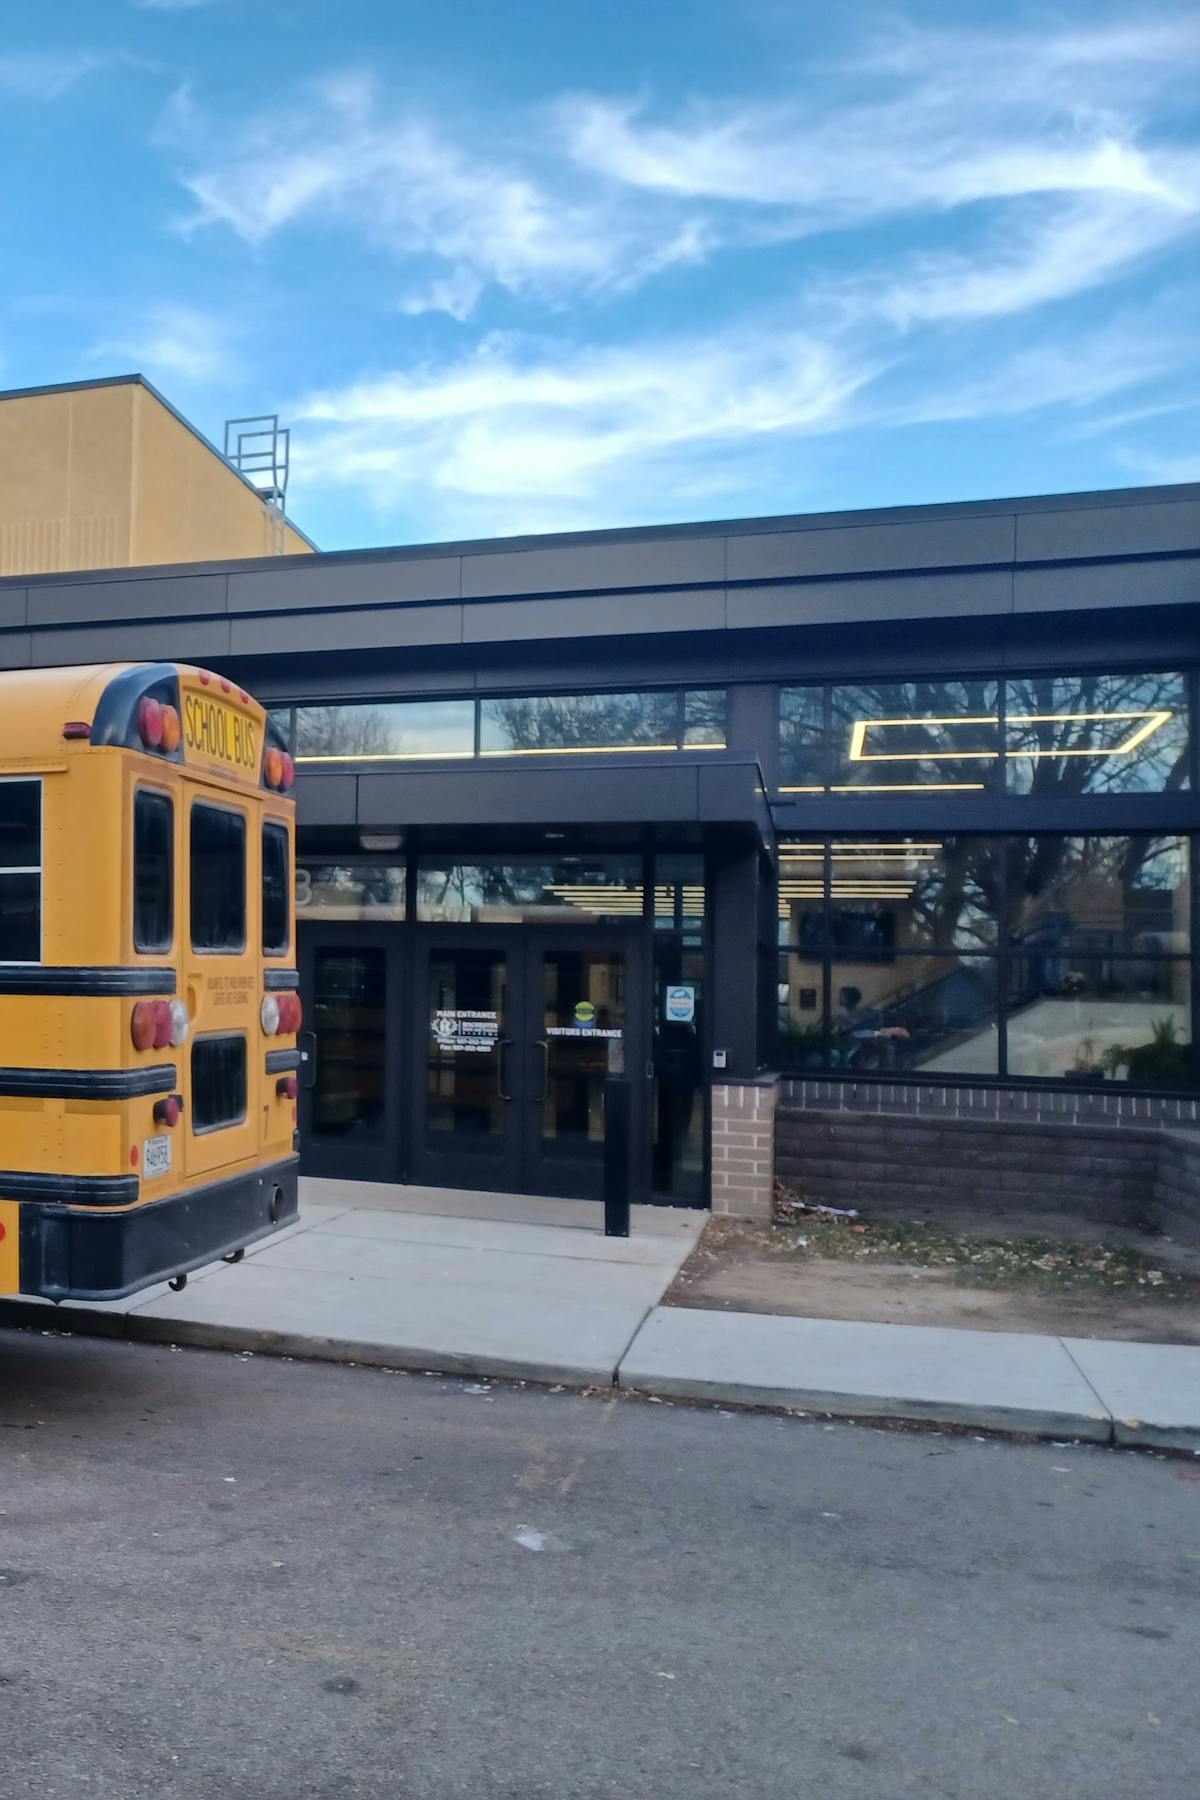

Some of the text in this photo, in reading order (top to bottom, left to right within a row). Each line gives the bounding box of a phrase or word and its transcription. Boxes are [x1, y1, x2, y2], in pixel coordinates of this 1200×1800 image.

[185, 694, 255, 769] SCHOOL BUS
[436, 1010, 497, 1019] MAIN ENTRANCE
[546, 1027, 622, 1038] VISITORS ENTRANCE
